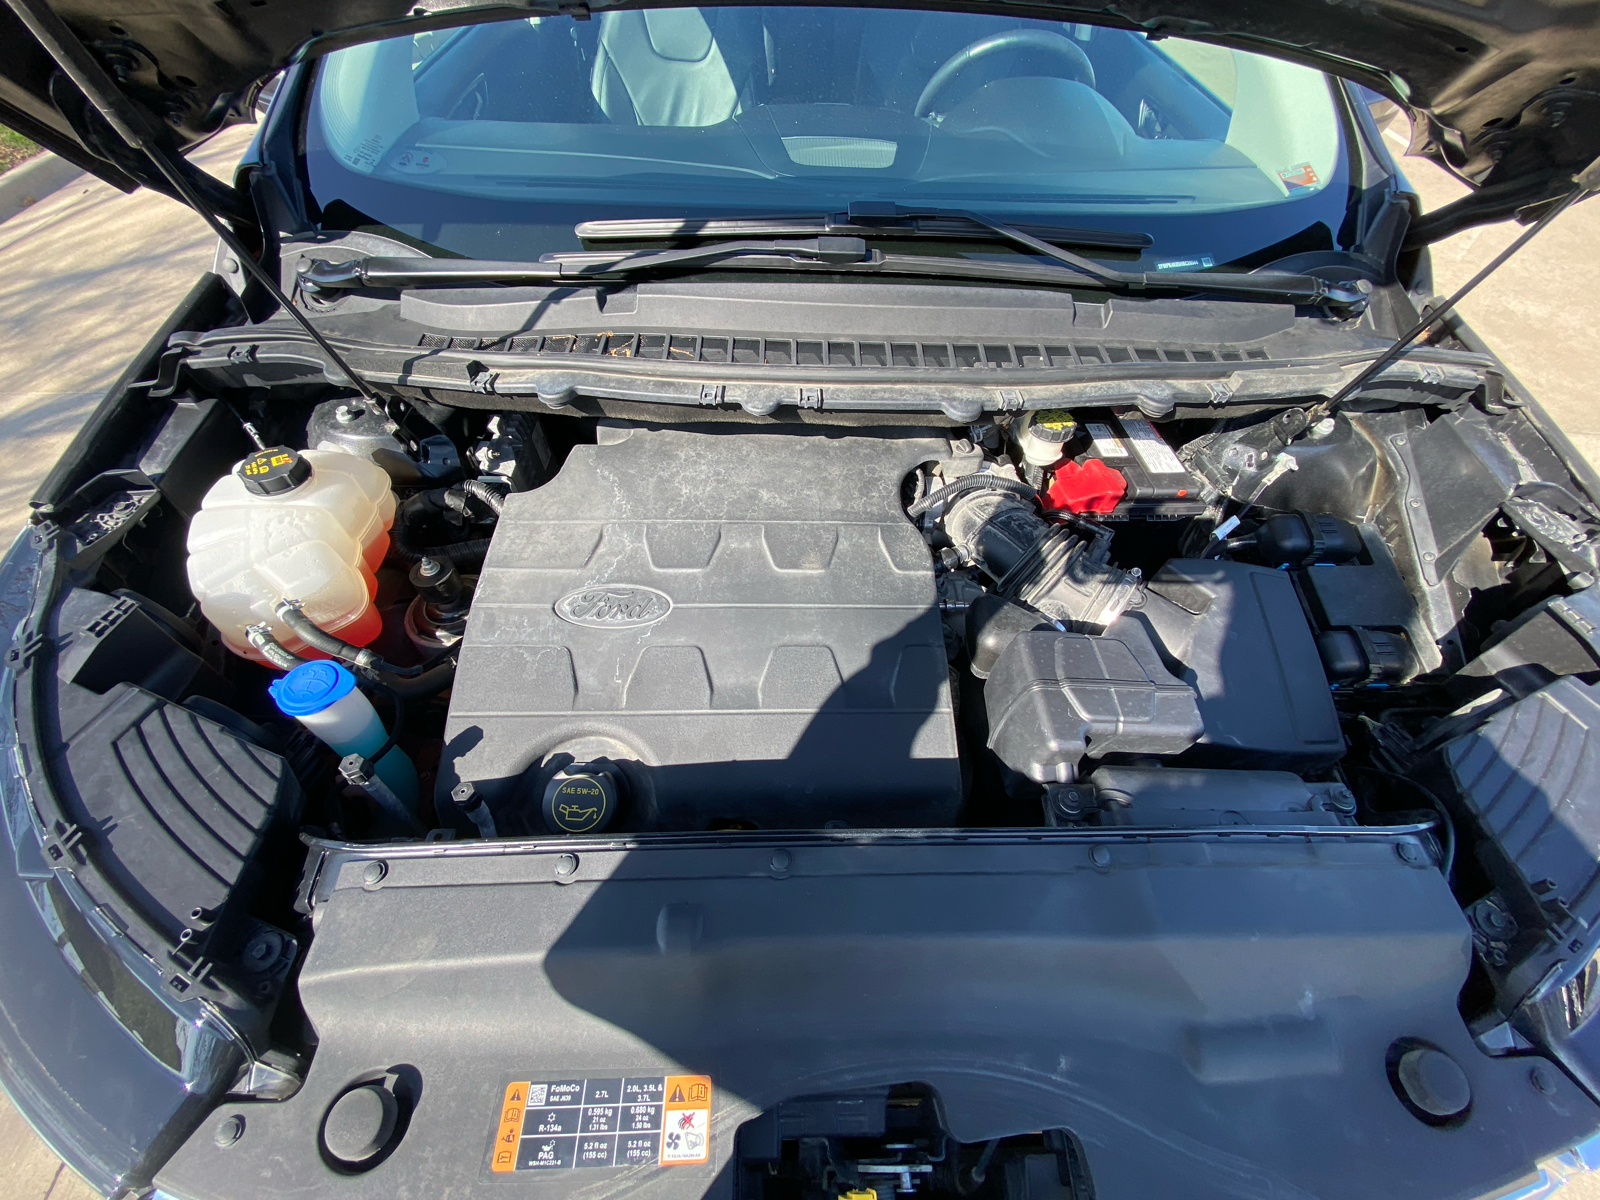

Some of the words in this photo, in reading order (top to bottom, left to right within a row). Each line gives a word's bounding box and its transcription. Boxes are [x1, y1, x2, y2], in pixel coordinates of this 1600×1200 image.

[570, 590, 654, 620] Ford
[550, 1084, 580, 1092] FoMoCo
[605, 1108, 612, 1116] kg
[647, 1106, 655, 1115] kg
